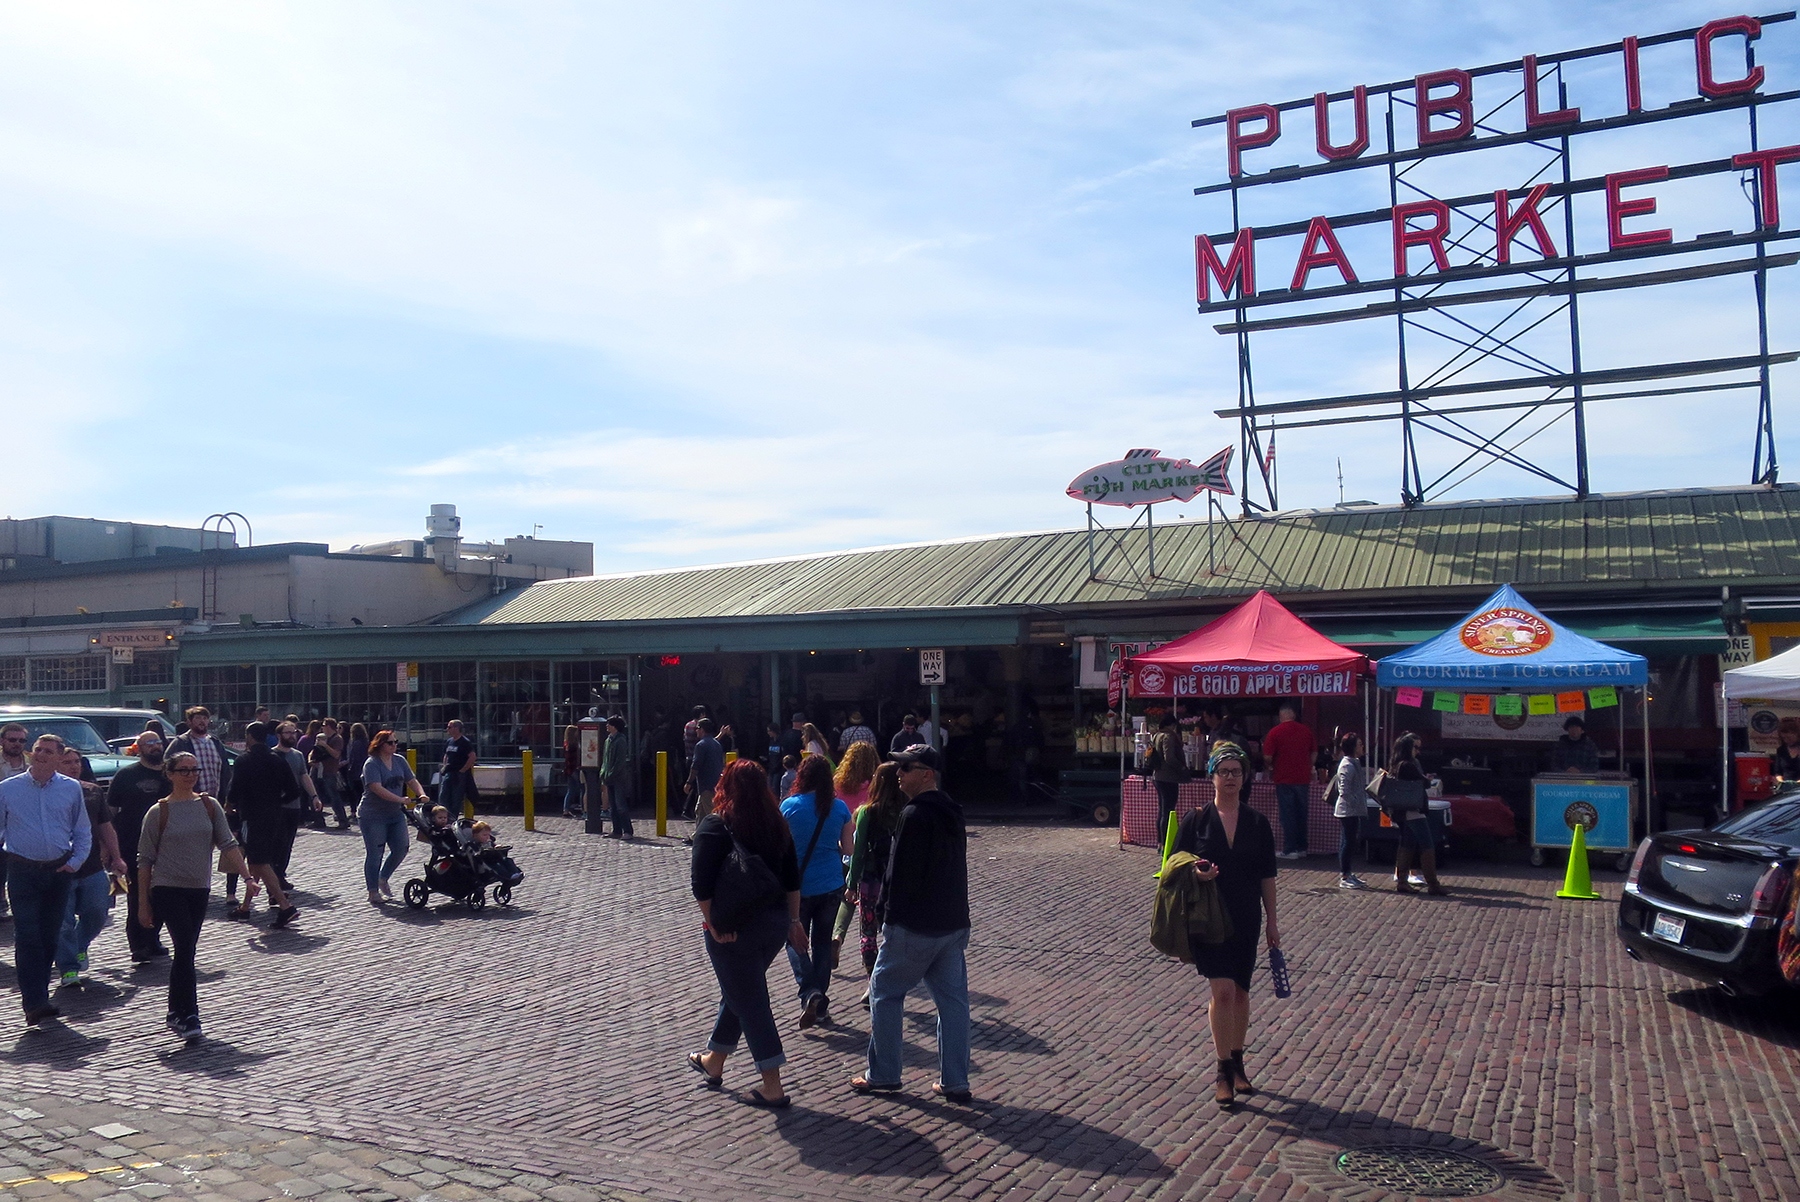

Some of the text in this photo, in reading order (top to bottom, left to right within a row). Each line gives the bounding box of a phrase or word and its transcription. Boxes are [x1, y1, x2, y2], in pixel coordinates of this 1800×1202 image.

[1226, 15, 1764, 178] PUBLIC
[1195, 145, 1800, 302] MARKET
[1122, 461, 1171, 476] CITY
[1083, 473, 1212, 495] FISH MARKET
[1465, 610, 1548, 638] SILVER SPRINGS
[922, 652, 941, 661] ONE
[1483, 647, 1531, 655] CREAMERY
[1721, 652, 1751, 663] WAY
[922, 662, 942, 670] WAY
[1191, 663, 1319, 674] Cold Pressed Organic
[1392, 662, 1632, 679] GOURMET ICECREAM
[1173, 670, 1350, 696] ICE COLD APPLE CIDER!
[1542, 790, 1580, 798] GOURMET
